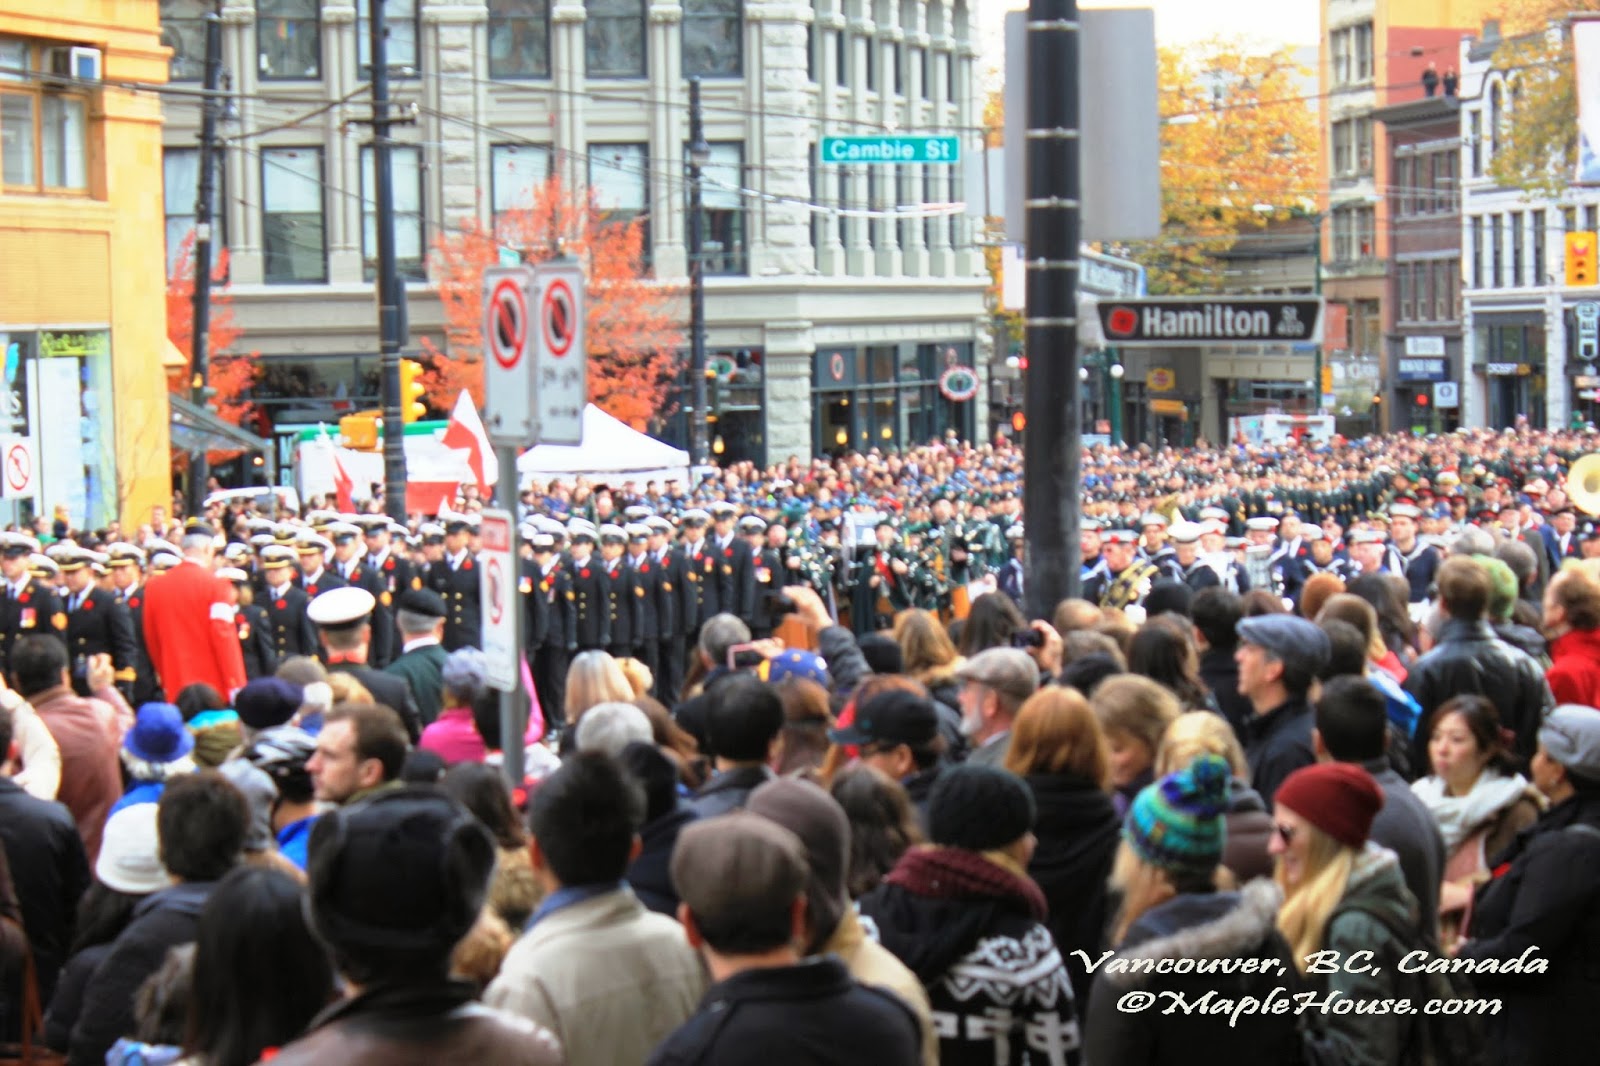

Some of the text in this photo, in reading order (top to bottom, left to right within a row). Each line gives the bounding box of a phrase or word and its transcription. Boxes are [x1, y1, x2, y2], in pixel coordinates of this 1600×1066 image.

[830, 139, 950, 160] Cambie St
[1142, 303, 1270, 337] Hamilton
